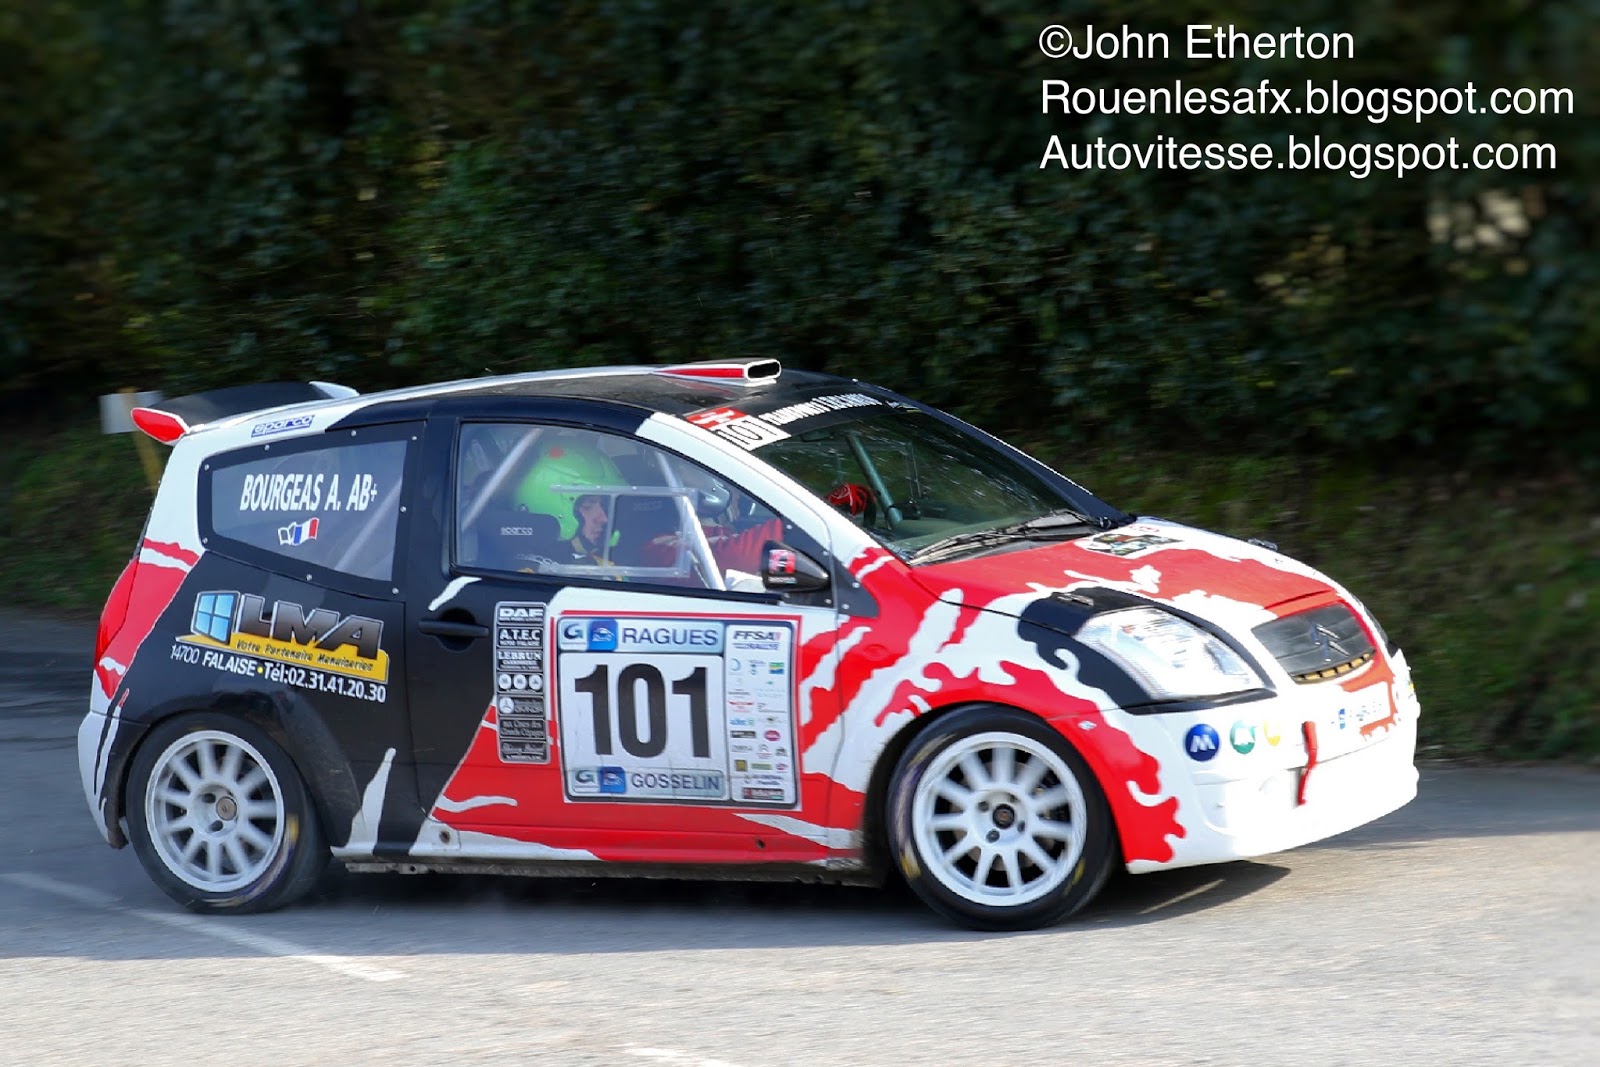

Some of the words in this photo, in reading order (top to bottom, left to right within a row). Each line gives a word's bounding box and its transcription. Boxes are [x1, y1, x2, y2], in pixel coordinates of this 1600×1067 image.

[240, 473, 324, 511] BOURGEAS
[324, 473, 342, 512] A.
[346, 473, 378, 512] AB+
[234, 593, 385, 660] LMA
[499, 608, 544, 617] DAF
[621, 627, 719, 646] RAGUES
[169, 644, 201, 665] 14700
[202, 651, 258, 678] FALAISE
[574, 663, 711, 759] 101
[631, 772, 720, 791] GOSSELIN
